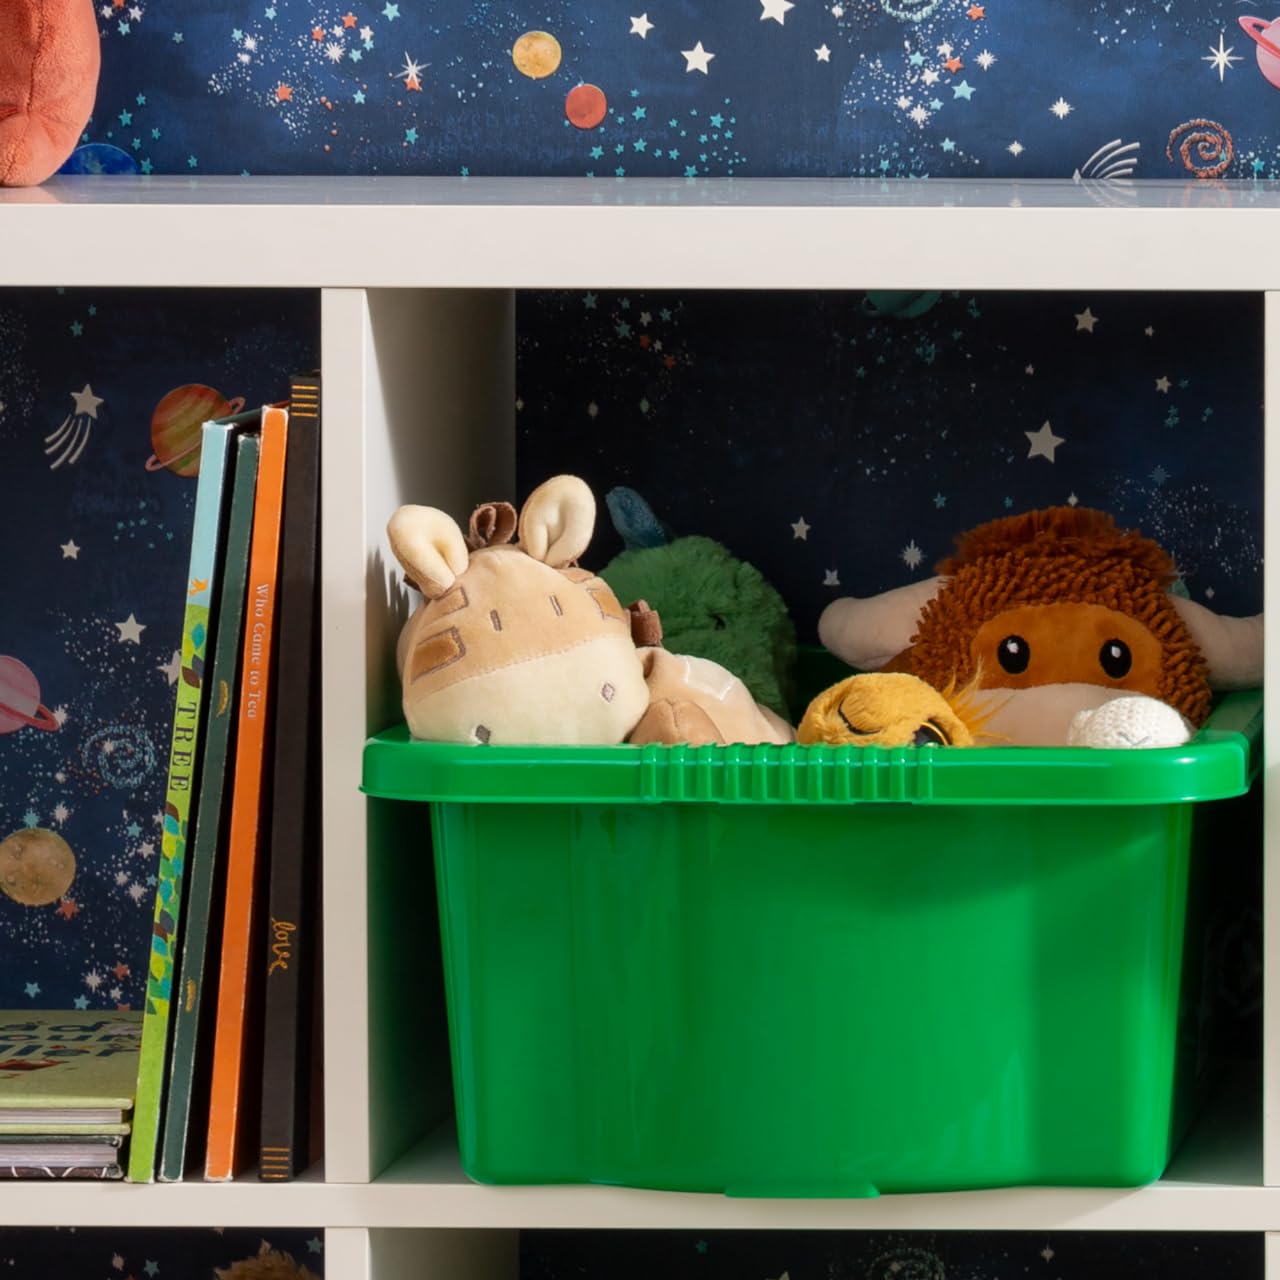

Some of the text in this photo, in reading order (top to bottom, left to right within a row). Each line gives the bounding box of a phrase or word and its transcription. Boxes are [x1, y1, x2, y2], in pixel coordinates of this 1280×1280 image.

[246, 582, 270, 719] Who Came to Tea
[170, 701, 198, 792] TREE
[268, 917, 297, 976] love
